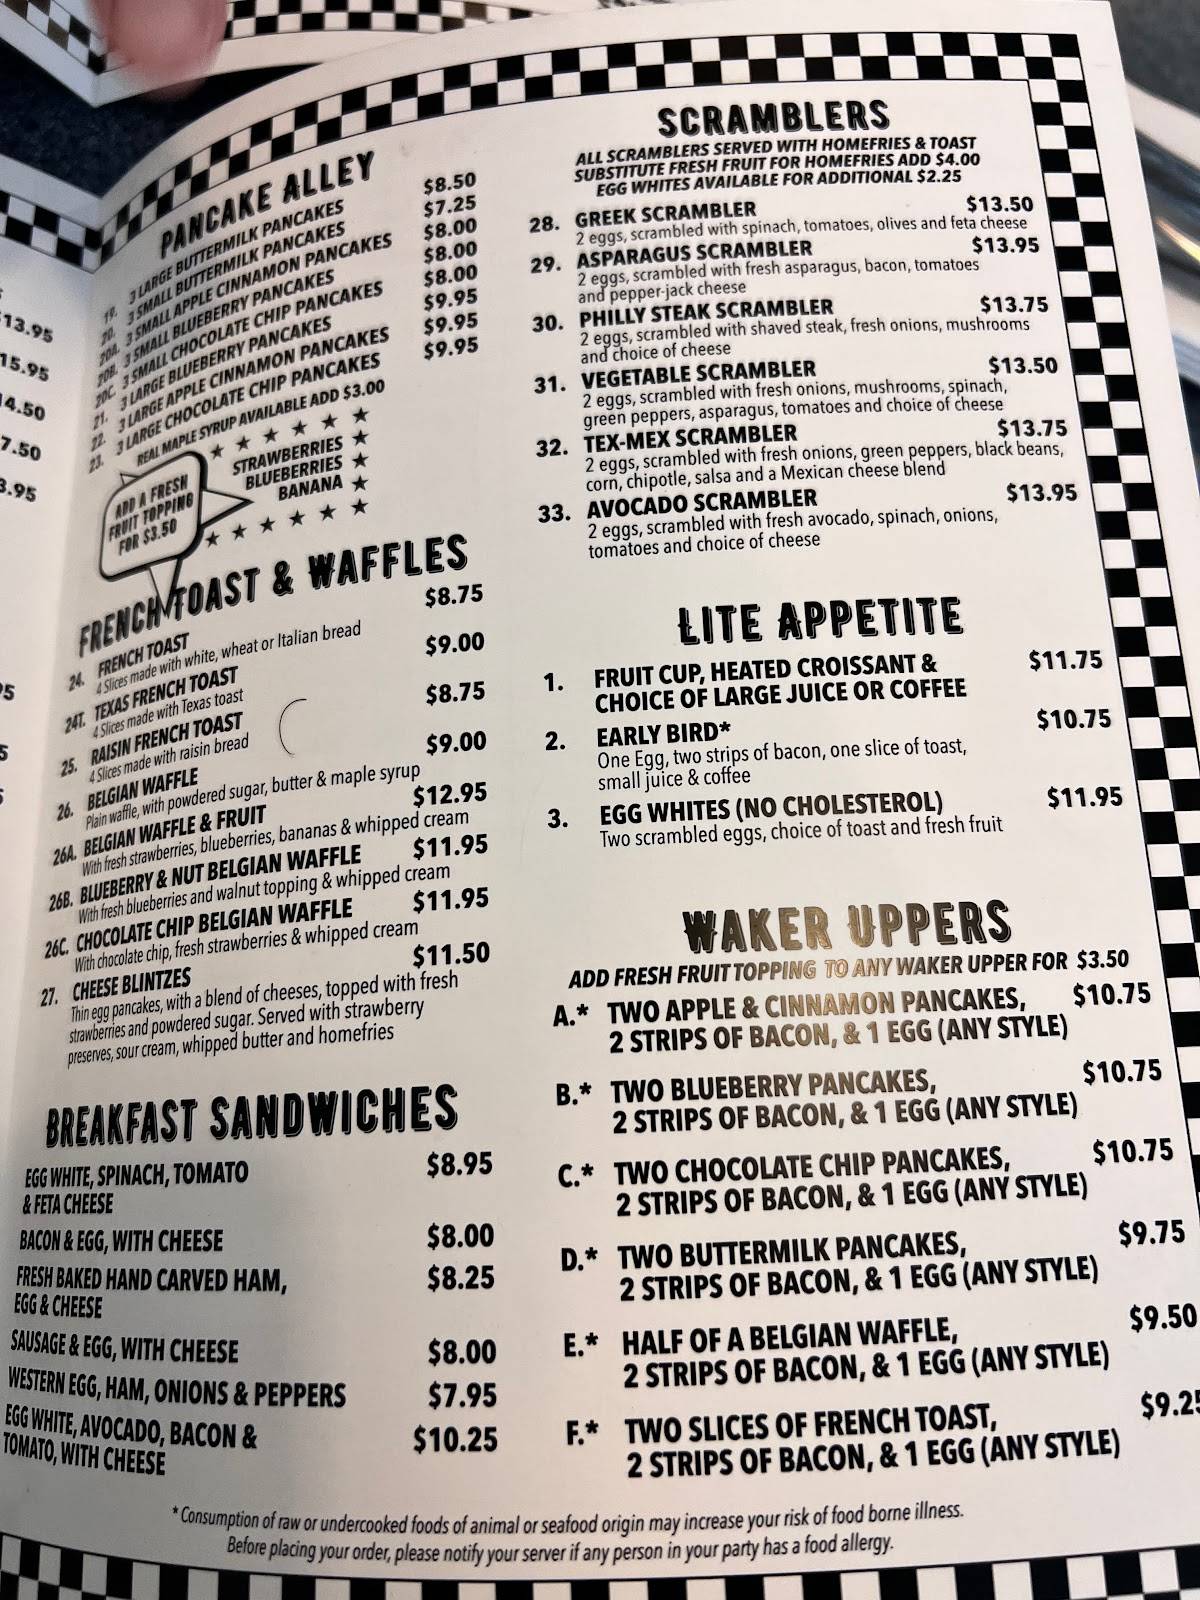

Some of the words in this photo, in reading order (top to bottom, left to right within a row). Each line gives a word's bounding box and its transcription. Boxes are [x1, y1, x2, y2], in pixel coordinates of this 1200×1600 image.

[657, 99, 889, 138] SCRAMBLERS
[575, 151, 603, 166] ALL
[606, 142, 709, 163] SCRAMBLERS
[713, 140, 772, 155] SERVED
[776, 138, 817, 152] WITH
[821, 136, 910, 151] HOMEFRIES
[914, 136, 926, 149] &
[929, 136, 976, 149] TOAST
[423, 171, 476, 196] $8.50
[596, 181, 627, 197] EGG
[631, 176, 690, 194] WHITES
[693, 172, 778, 190] AVAILABLE
[782, 171, 813, 185] FOR
[816, 169, 912, 184] ADDITIONAL
[916, 168, 961, 183] $2.25
[160, 182, 273, 260] PANCAKE
[283, 150, 375, 204] ALLEY
[529, 215, 559, 233] 28.
[575, 207, 636, 228] GREEK
[641, 200, 756, 223] SCRAMBLER
[966, 194, 1033, 213] $13.50
[576, 230, 584, 245] 2
[588, 231, 626, 249] eggs,
[630, 221, 703, 241] scrambled
[707, 220, 737, 235] with
[742, 218, 800, 237] spinach,
[803, 218, 873, 232] tomatoes,
[876, 215, 916, 230] olives
[920, 215, 946, 229] and
[950, 214, 976, 229] feta
[980, 214, 1027, 229] cheese
[129, 289, 136, 305] 3
[138, 268, 173, 301] LARGE
[176, 226, 258, 276] BUTTERMILK
[262, 199, 344, 237] PANCAKES
[532, 314, 563, 332] 30.
[579, 307, 646, 328] PHILLY
[650, 304, 711, 322] STEAK
[715, 298, 833, 319] SCRAMBLER
[980, 296, 1048, 314] $13.75
[0, 312, 53, 344] 13.95
[580, 345, 610, 364] and
[612, 345, 658, 361] choice
[662, 341, 676, 358] of
[681, 341, 730, 357] cheese
[137, 450, 159, 467] REAL
[161, 435, 196, 460] MAPLE
[199, 417, 237, 441] SYRUP
[239, 397, 307, 426] AVAILABLE
[310, 388, 340, 409] ADD
[343, 379, 385, 401] $3.00
[233, 436, 343, 476] STRAWBERRIES
[245, 455, 343, 491] BLUEBERRIES
[116, 496, 136, 520] ADD
[139, 491, 146, 512] A
[151, 474, 188, 506] FRESH
[279, 475, 343, 501] BANANA
[1006, 483, 1077, 503] $13.95
[109, 513, 138, 541] FRUIT
[144, 492, 194, 527] TOPPING
[538, 503, 570, 523] 33.
[586, 496, 687, 519] AVOCADO
[693, 488, 817, 512] SCRAMBLER
[119, 532, 139, 555] FOR
[144, 518, 177, 545] $3.50
[588, 542, 659, 558] tomatoes
[663, 535, 691, 553] and
[696, 534, 744, 551] choice
[749, 531, 763, 548] of
[768, 531, 820, 548] cheese
[78, 597, 163, 657] FRENCH
[172, 567, 260, 621] TOAST
[272, 561, 294, 597] &
[310, 533, 469, 589] WAFFLES
[677, 603, 762, 645] LITE
[777, 596, 963, 640] APPETITE
[543, 672, 563, 691] 1.
[594, 665, 653, 688] FRUIT
[658, 663, 704, 685] CUP,
[710, 659, 791, 681] HEATED
[797, 653, 915, 677] CROISSANT
[921, 653, 937, 672] &
[1029, 649, 1102, 671] $11.75
[426, 730, 486, 756] $9.00
[56, 801, 73, 821] 26.
[87, 780, 138, 811] BELGIAN
[142, 766, 198, 796] WAFFLE
[413, 781, 486, 808] $12.95
[598, 770, 640, 790] small
[644, 770, 682, 792] juice
[687, 768, 699, 785] &
[703, 765, 750, 785] coffee
[547, 808, 568, 828] 3.
[600, 803, 641, 825] EGG
[646, 799, 730, 822] WHITES
[735, 797, 776, 822] (NO
[782, 790, 942, 816] CHOLESTEROL)
[1047, 786, 1122, 809] $11.95
[683, 906, 832, 954] WAKER
[847, 899, 1011, 947] UPPERS
[412, 941, 489, 969] $11.50
[40, 986, 58, 1007] 27.
[72, 976, 118, 1001] CHEESE
[121, 966, 191, 994] BLINTZES
[1073, 981, 1150, 1008] $10.75
[69, 1022, 125, 1043] strawberries
[127, 1016, 148, 1037] and
[151, 1010, 210, 1039] powdered
[214, 1012, 254, 1032] sugar.
[257, 1003, 304, 1025] Served
[309, 1000, 339, 1021] with
[344, 997, 424, 1019] strawberry
[609, 999, 659, 1024] TWO
[665, 997, 736, 1021] APPLE
[742, 996, 759, 1019] &
[765, 991, 894, 1018] CINNAMON
[901, 986, 1025, 1012] PANCAKES,
[45, 1098, 197, 1148] BREAKFAST
[209, 1084, 457, 1140] SANDWICHES
[426, 1151, 492, 1178] $8.95
[19, 1229, 60, 1250] BACON
[63, 1229, 73, 1251] &
[76, 1229, 108, 1254] EGG,
[112, 1229, 153, 1252] WITH
[158, 1228, 223, 1252] CHEESE
[427, 1222, 494, 1250] $8.00
[619, 1276, 634, 1301] 2
[641, 1272, 722, 1301] STRIPS
[729, 1272, 760, 1297] OF
[767, 1267, 858, 1295] BACON,
[864, 1266, 883, 1291] &
[888, 1265, 901, 1289] 1
[910, 1262, 956, 1288] EGG
[962, 1259, 1018, 1290] (ANY
[1024, 1256, 1098, 1284] STYLE)
[1129, 1303, 1197, 1333] $9.50
[226, 1535, 266, 1555] Before
[268, 1538, 316, 1563] placing
[318, 1545, 350, 1563] your
[352, 1541, 390, 1563] order,
[393, 1542, 440, 1566] please
[443, 1542, 484, 1567] notify
[485, 1548, 520, 1567] your
[521, 1547, 566, 1562] server
[569, 1541, 580, 1561] if
[582, 1547, 609, 1566] any
[612, 1545, 662, 1566] person
[667, 1545, 681, 1559] in
[684, 1543, 719, 1564] your
[721, 1539, 759, 1562] party
[762, 1535, 788, 1555] has
[791, 1540, 800, 1554] a
[804, 1532, 837, 1554] food
[840, 1531, 893, 1555] allergy.
